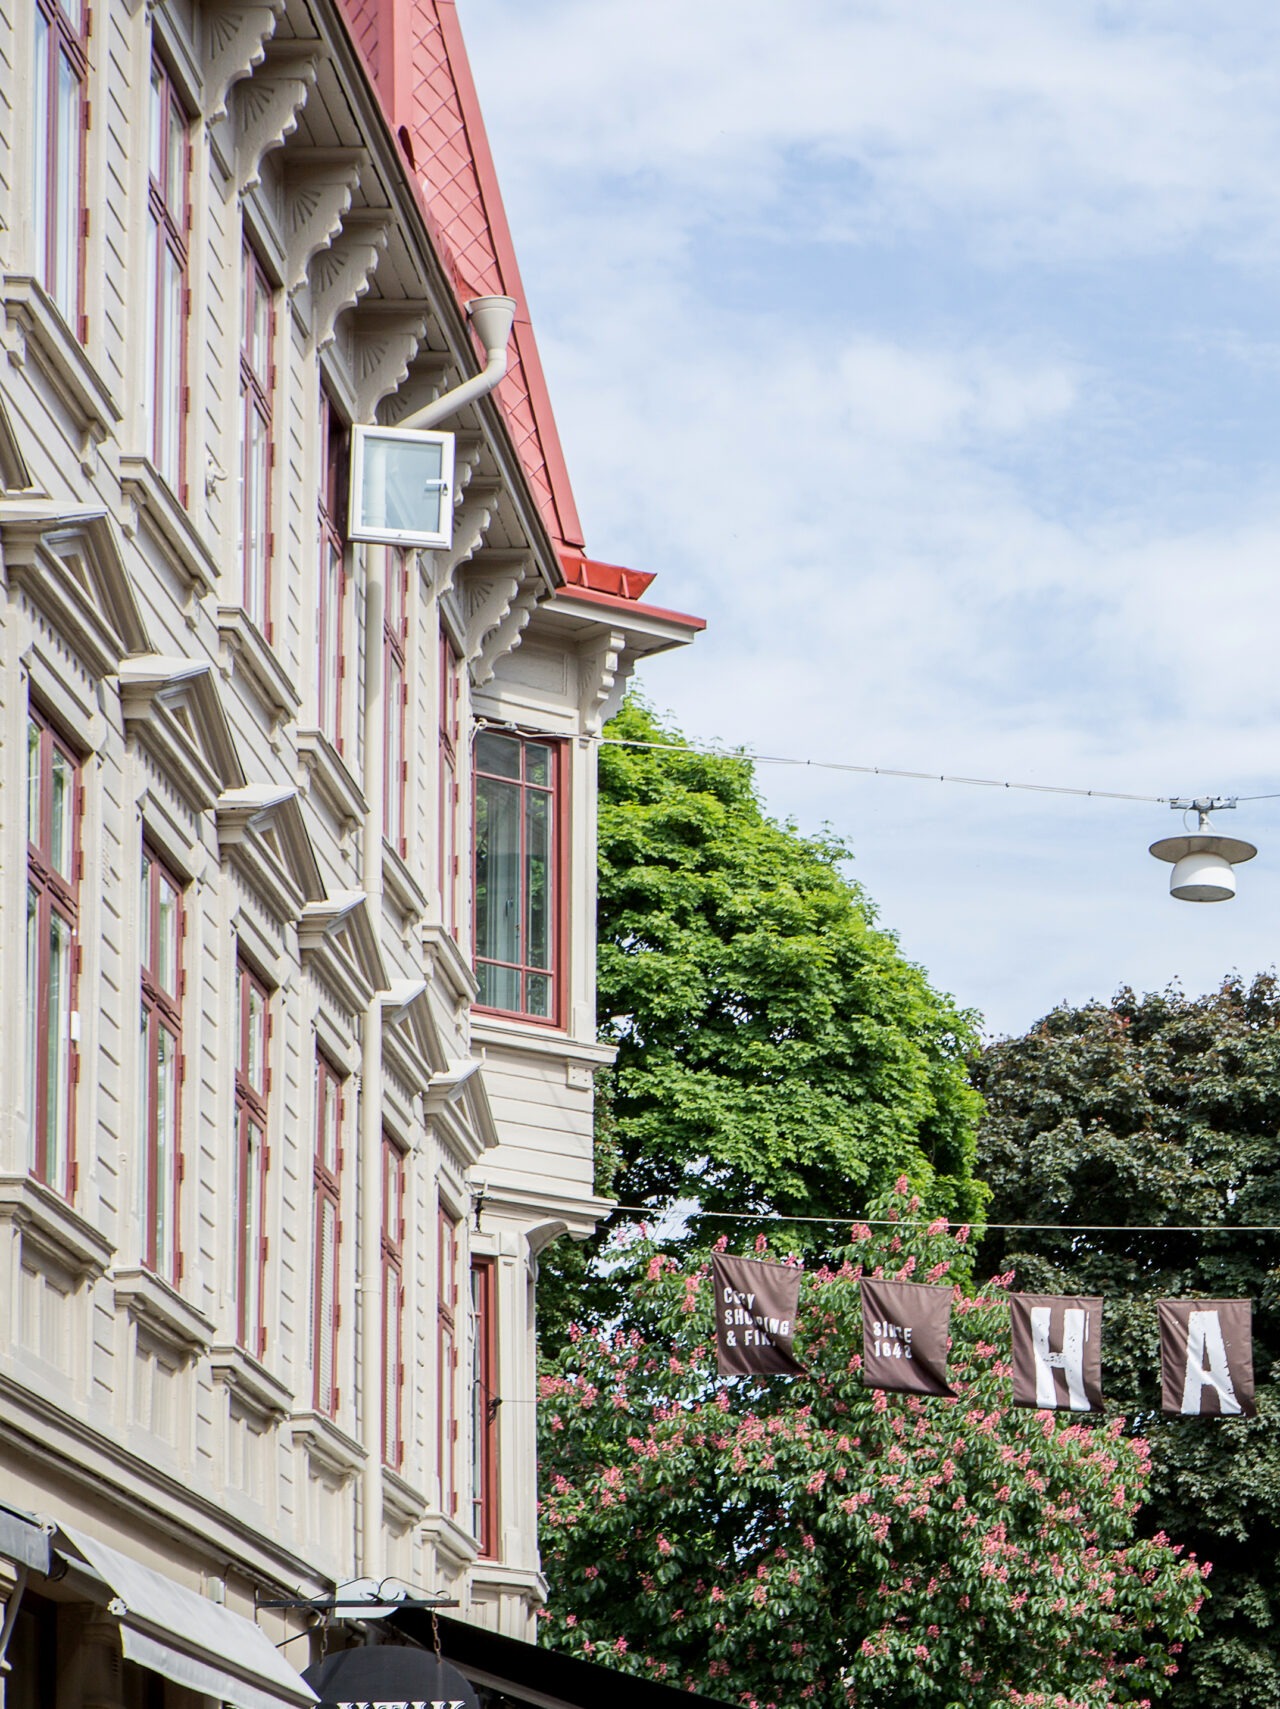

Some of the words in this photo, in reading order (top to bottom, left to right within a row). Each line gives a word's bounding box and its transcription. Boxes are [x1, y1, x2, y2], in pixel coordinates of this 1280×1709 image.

[724, 1308, 790, 1336] SHOPING
[726, 1330, 737, 1347] &
[744, 1329, 776, 1347] FIK
